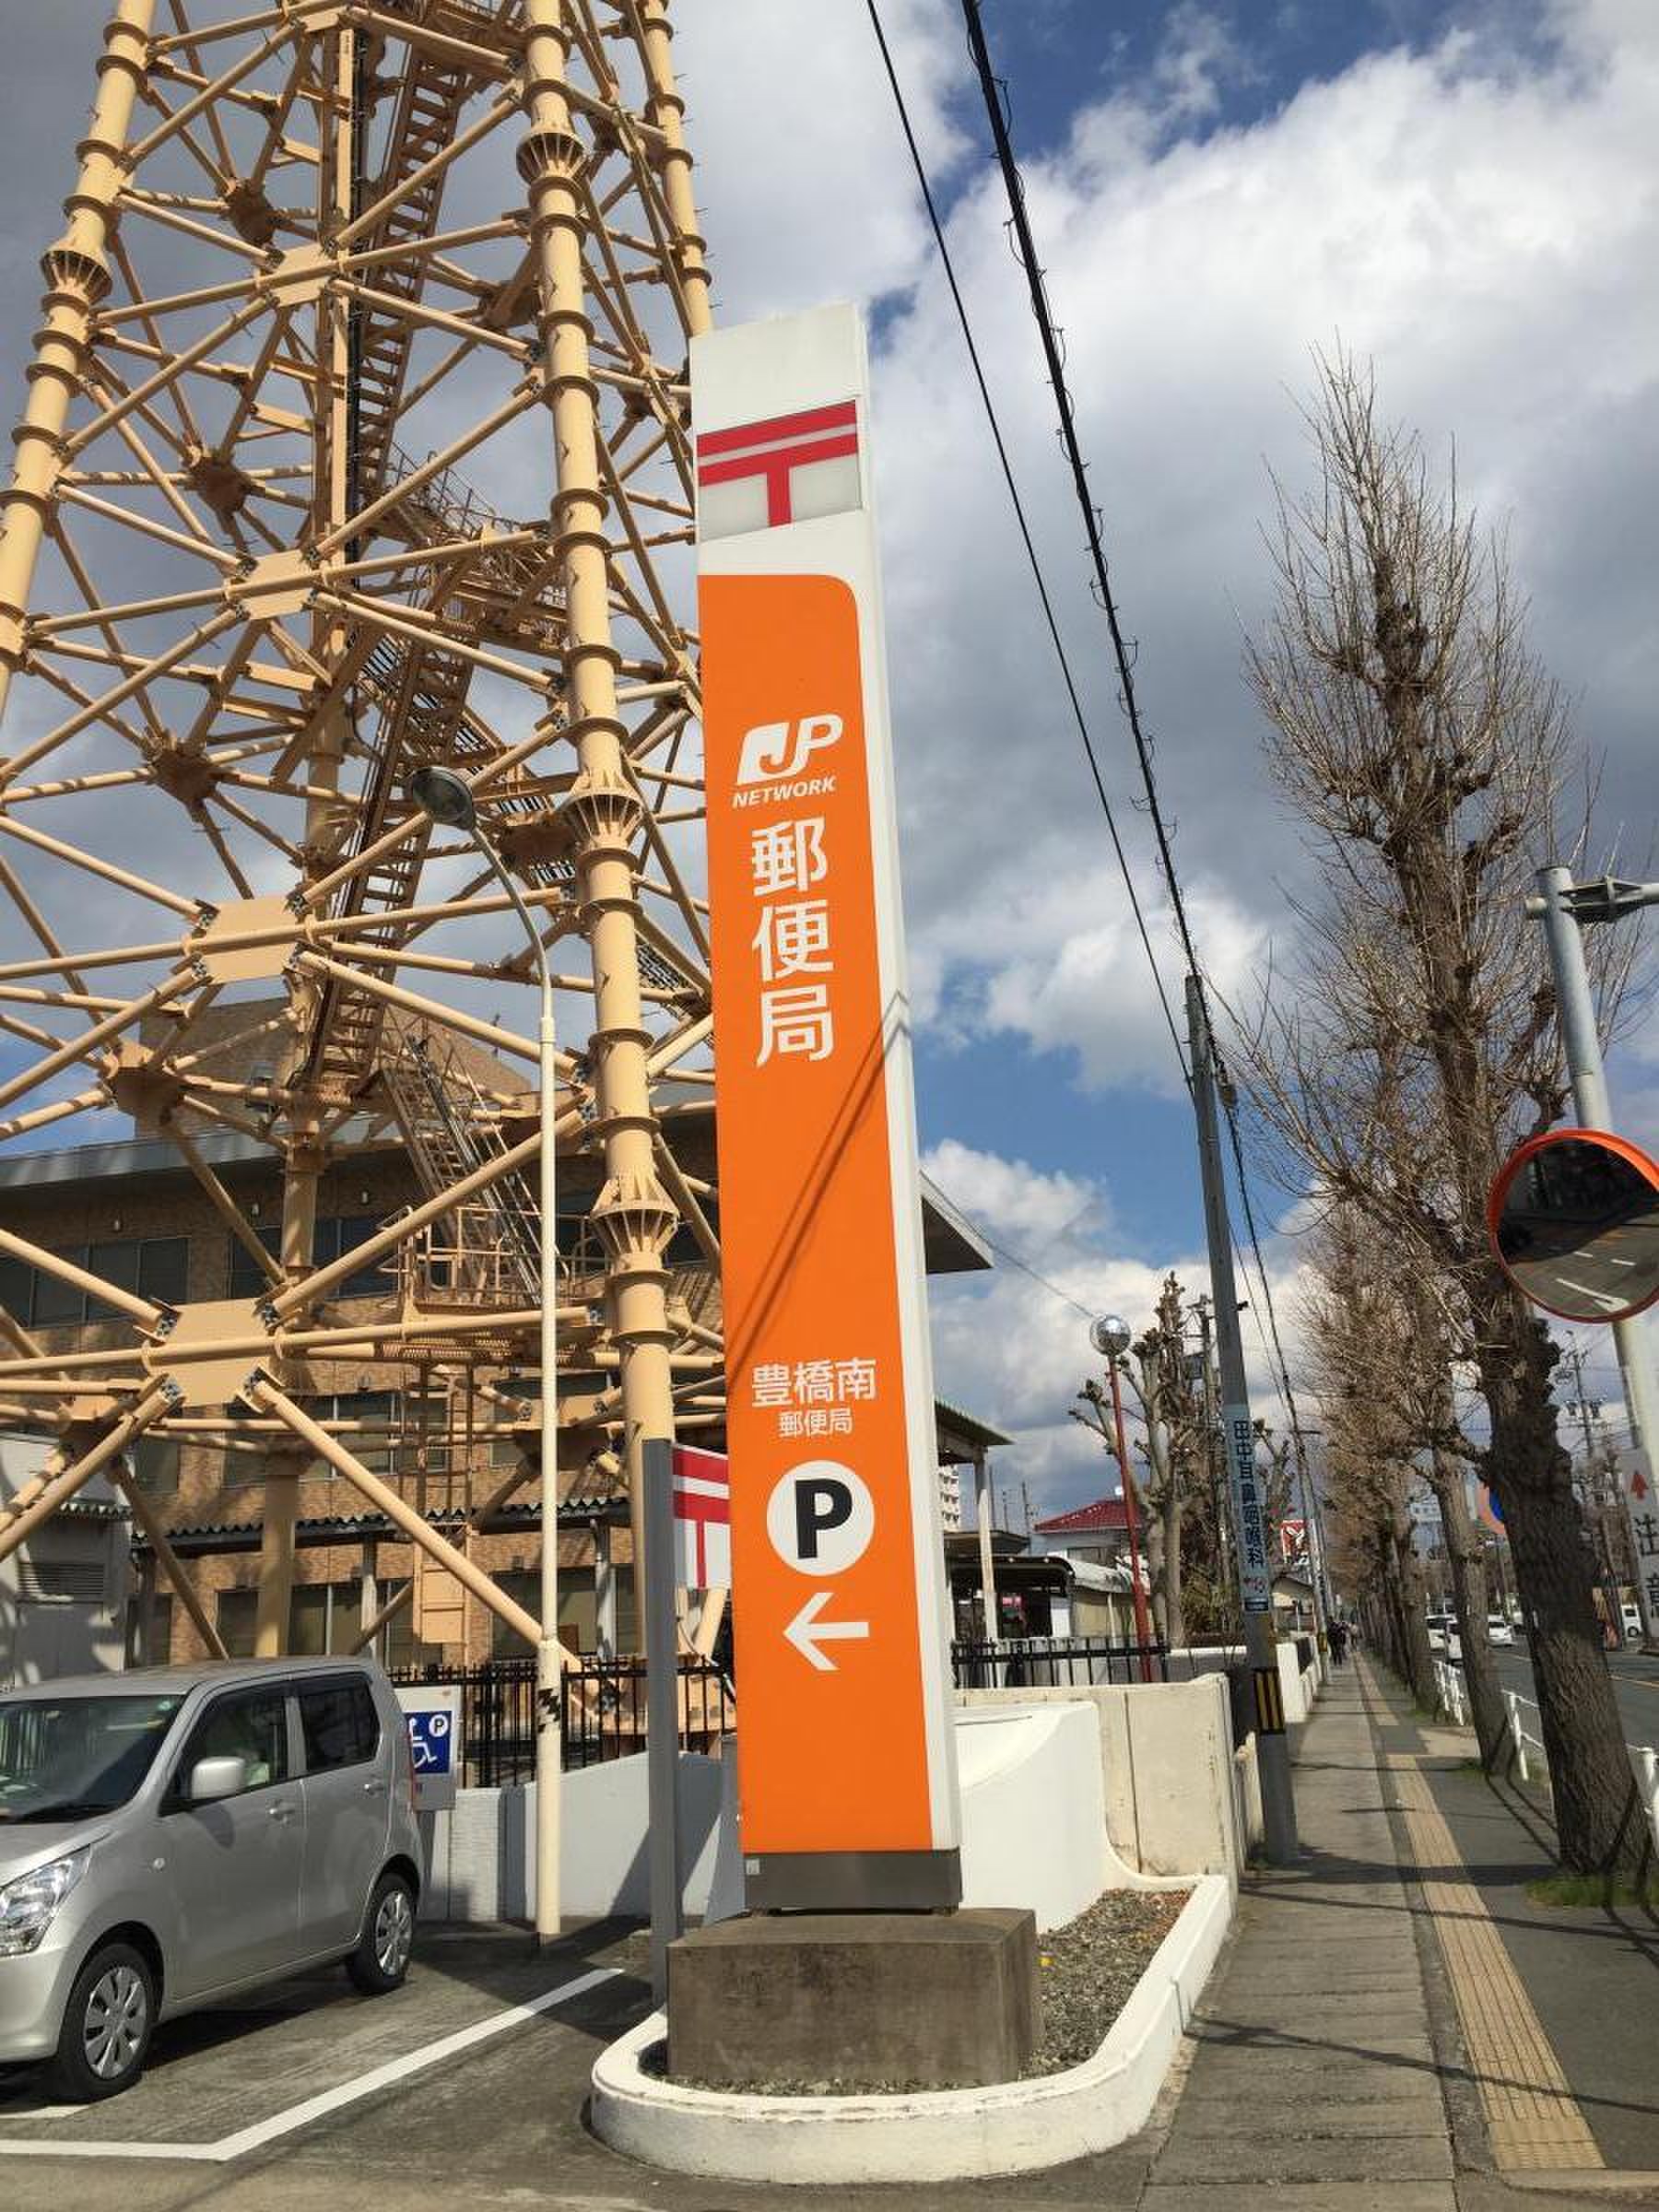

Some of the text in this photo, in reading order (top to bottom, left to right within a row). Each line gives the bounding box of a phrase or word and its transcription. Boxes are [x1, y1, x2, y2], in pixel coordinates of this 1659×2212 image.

[732, 775, 837, 809] NETWORK
[751, 817, 834, 1068] 郵便局
[752, 1358, 877, 1407] 豊橋南
[778, 1407, 853, 1438] 郵便局
[794, 1477, 853, 1559] P
